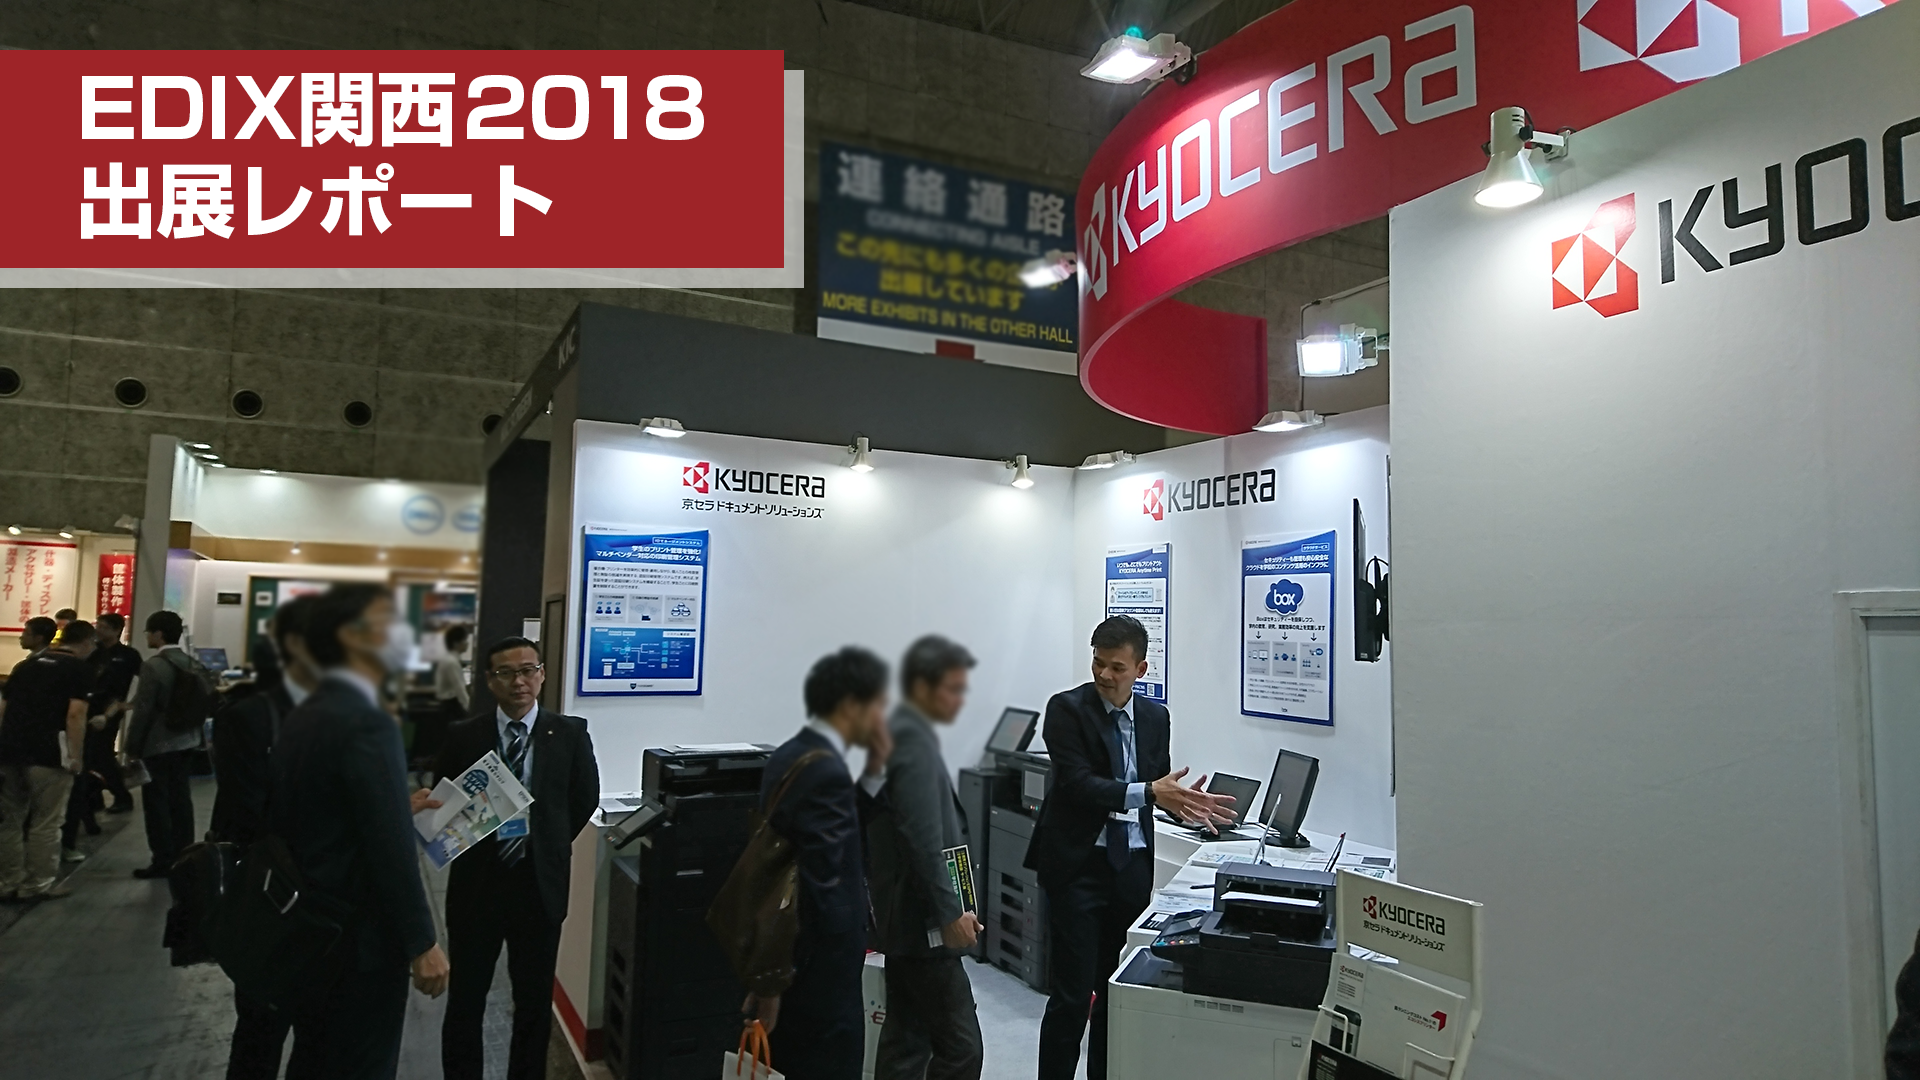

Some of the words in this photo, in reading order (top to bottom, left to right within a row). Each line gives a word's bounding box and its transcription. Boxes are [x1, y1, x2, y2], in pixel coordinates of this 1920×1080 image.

[1112, 4, 1477, 267] KYOCERA
[822, 291, 868, 314] MORE
[871, 299, 938, 325] EXHIBITS
[941, 311, 956, 328] IN
[960, 314, 988, 332] THE
[990, 317, 1037, 339] OTHER
[1039, 326, 1074, 344] HALL
[714, 467, 826, 499] KYOCERA
[1167, 468, 1276, 513] KYOCERA
[40, 549, 56, 617] 什器・ディスプレ
[1273, 588, 1296, 606] box
[1379, 902, 1446, 936] KYOCERA
